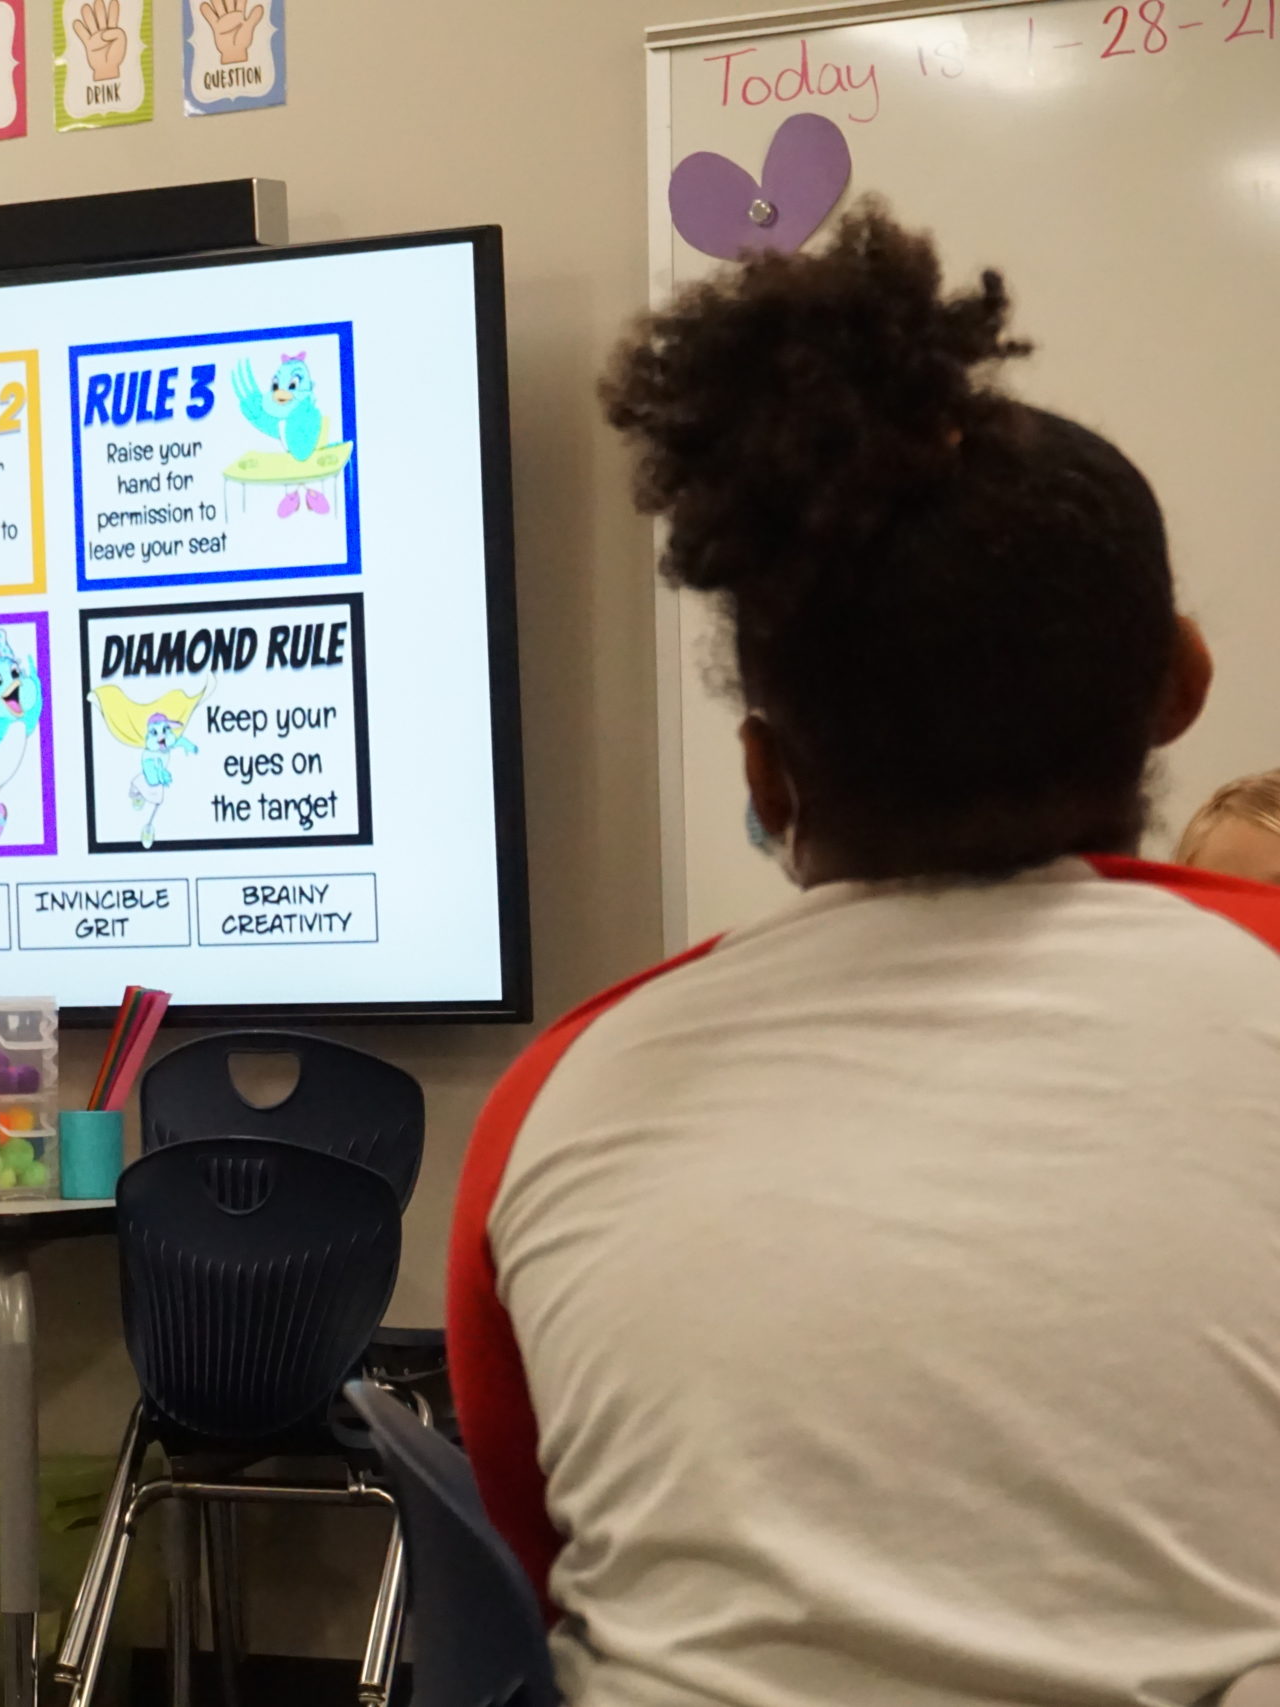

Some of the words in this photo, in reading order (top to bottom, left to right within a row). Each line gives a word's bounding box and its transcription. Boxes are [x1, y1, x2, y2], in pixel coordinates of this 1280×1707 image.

[203, 66, 263, 91] QUESTION
[703, 39, 879, 123] Today
[86, 82, 122, 106] DRINK
[84, 367, 178, 427] RULE
[186, 363, 216, 421] 3
[107, 442, 153, 463] Raise
[159, 440, 202, 464] your
[118, 473, 161, 494] hand
[166, 471, 193, 491] for
[98, 504, 193, 532] permission
[200, 501, 216, 521] to
[2, 521, 18, 540] to
[89, 541, 135, 561] leave
[142, 538, 183, 563] your
[189, 532, 227, 553] seat
[101, 627, 258, 679] DIAMOND
[266, 621, 348, 671] RULE
[207, 705, 268, 738] Keep
[276, 705, 337, 738] your
[223, 752, 284, 785] eyes
[292, 752, 323, 775] on
[211, 794, 251, 823] the
[257, 790, 338, 831] target
[35, 889, 170, 912] INVINCIBLE
[242, 884, 329, 906] BRAINY
[75, 917, 130, 938] GRIT
[222, 912, 352, 935] CREATIVITY
